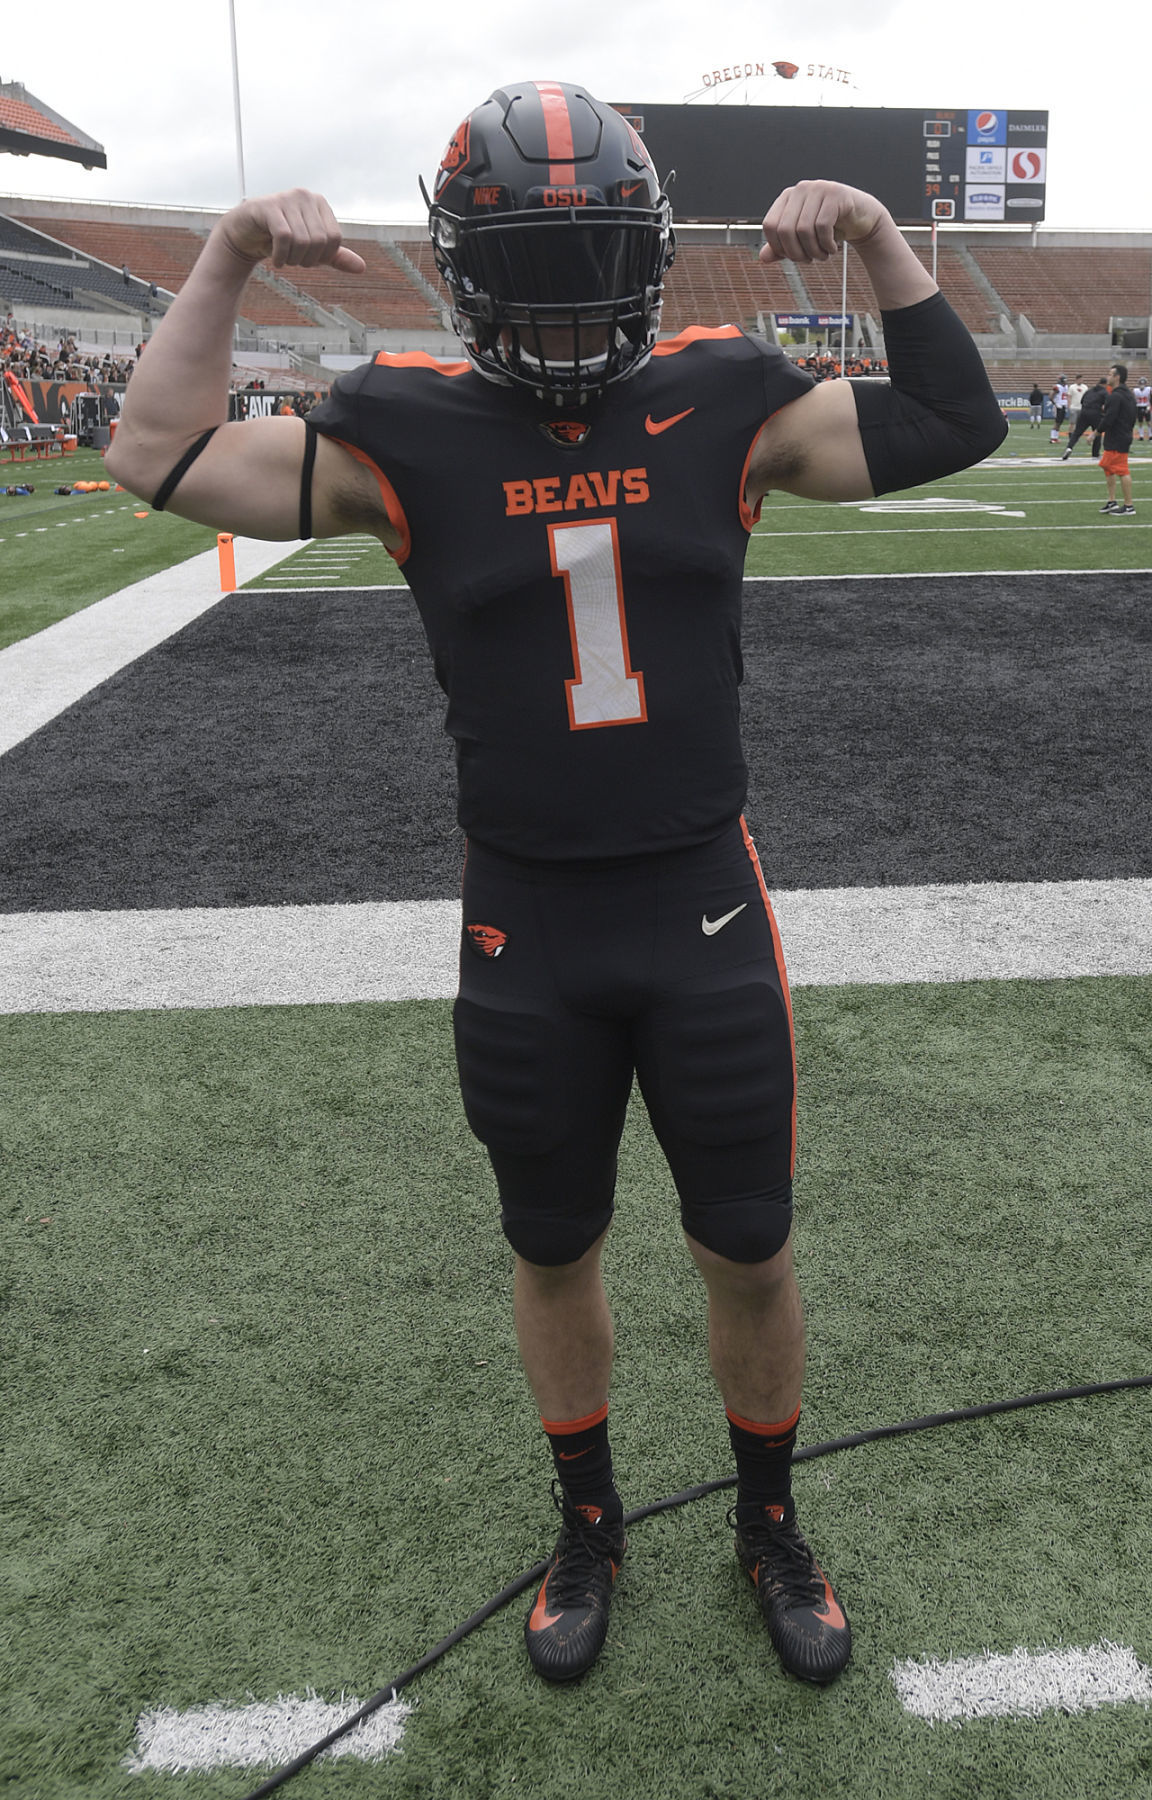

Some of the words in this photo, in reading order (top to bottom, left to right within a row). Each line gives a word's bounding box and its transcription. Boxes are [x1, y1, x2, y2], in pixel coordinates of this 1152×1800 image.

[702, 63, 764, 87] OREGON
[807, 64, 851, 84] STATE
[1008, 124, 1046, 132] DAIMLER
[473, 186, 501, 205] NIKE
[543, 188, 587, 207] OSU
[935, 202, 952, 215] 25
[502, 467, 650, 516] BEAVS
[547, 517, 648, 730] 1
